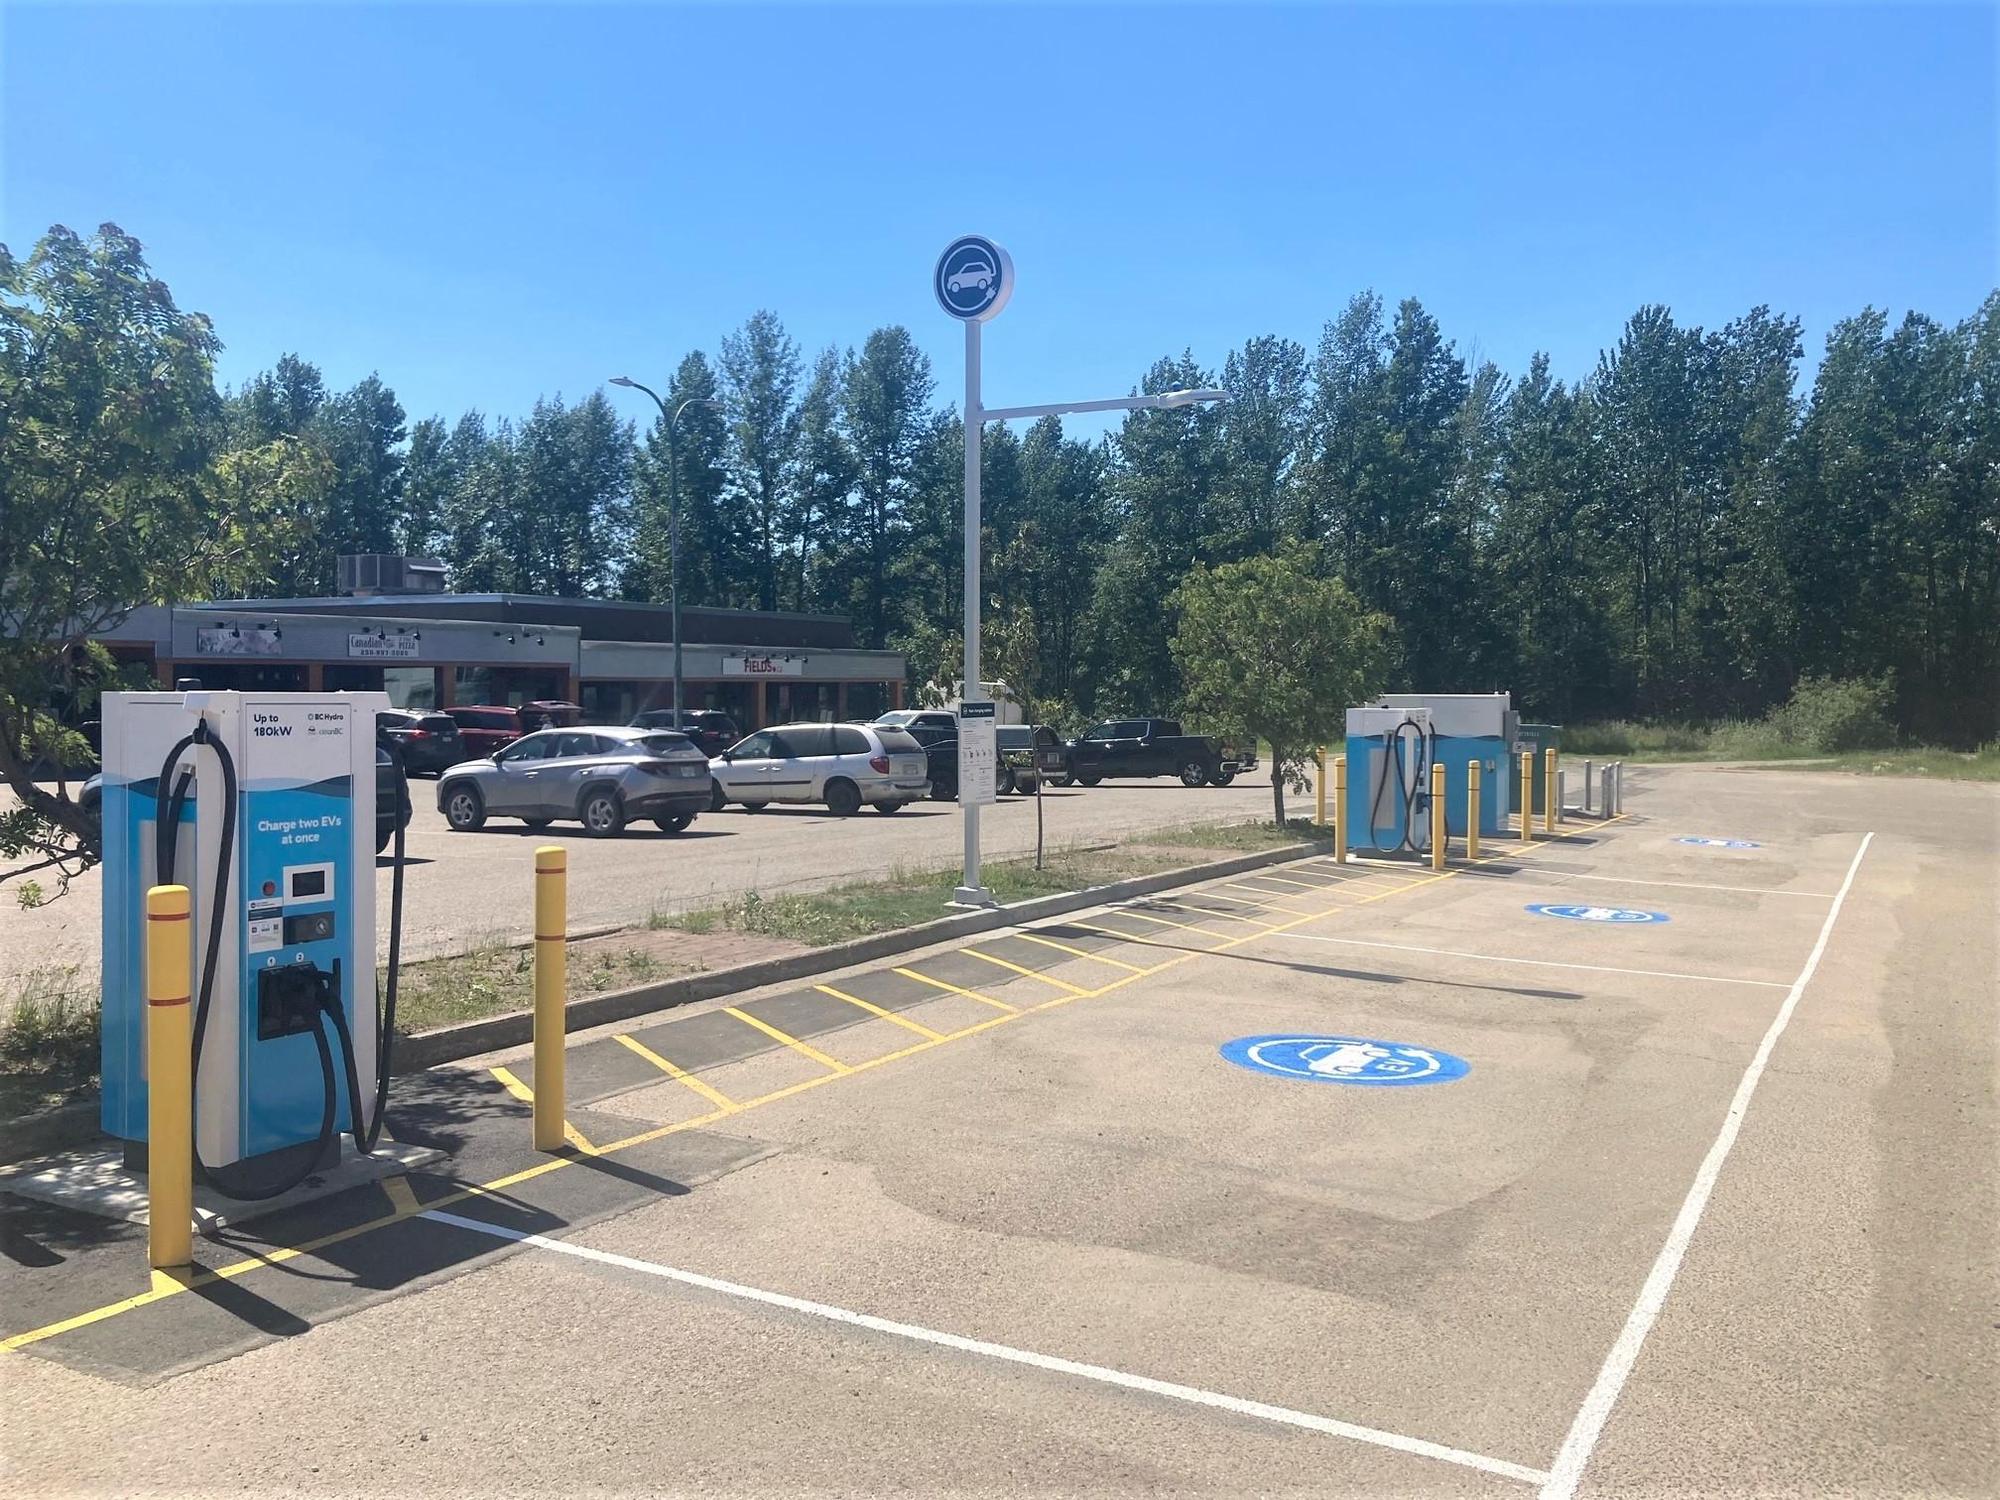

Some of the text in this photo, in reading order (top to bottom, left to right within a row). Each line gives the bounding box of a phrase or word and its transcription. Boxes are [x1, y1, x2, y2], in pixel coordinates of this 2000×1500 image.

[253, 713, 279, 725] Up to
[314, 713, 344, 721] BC Hydro
[253, 726, 293, 737] 180kW
[258, 815, 342, 832] Charge two EVs
[281, 833, 320, 845] at once
